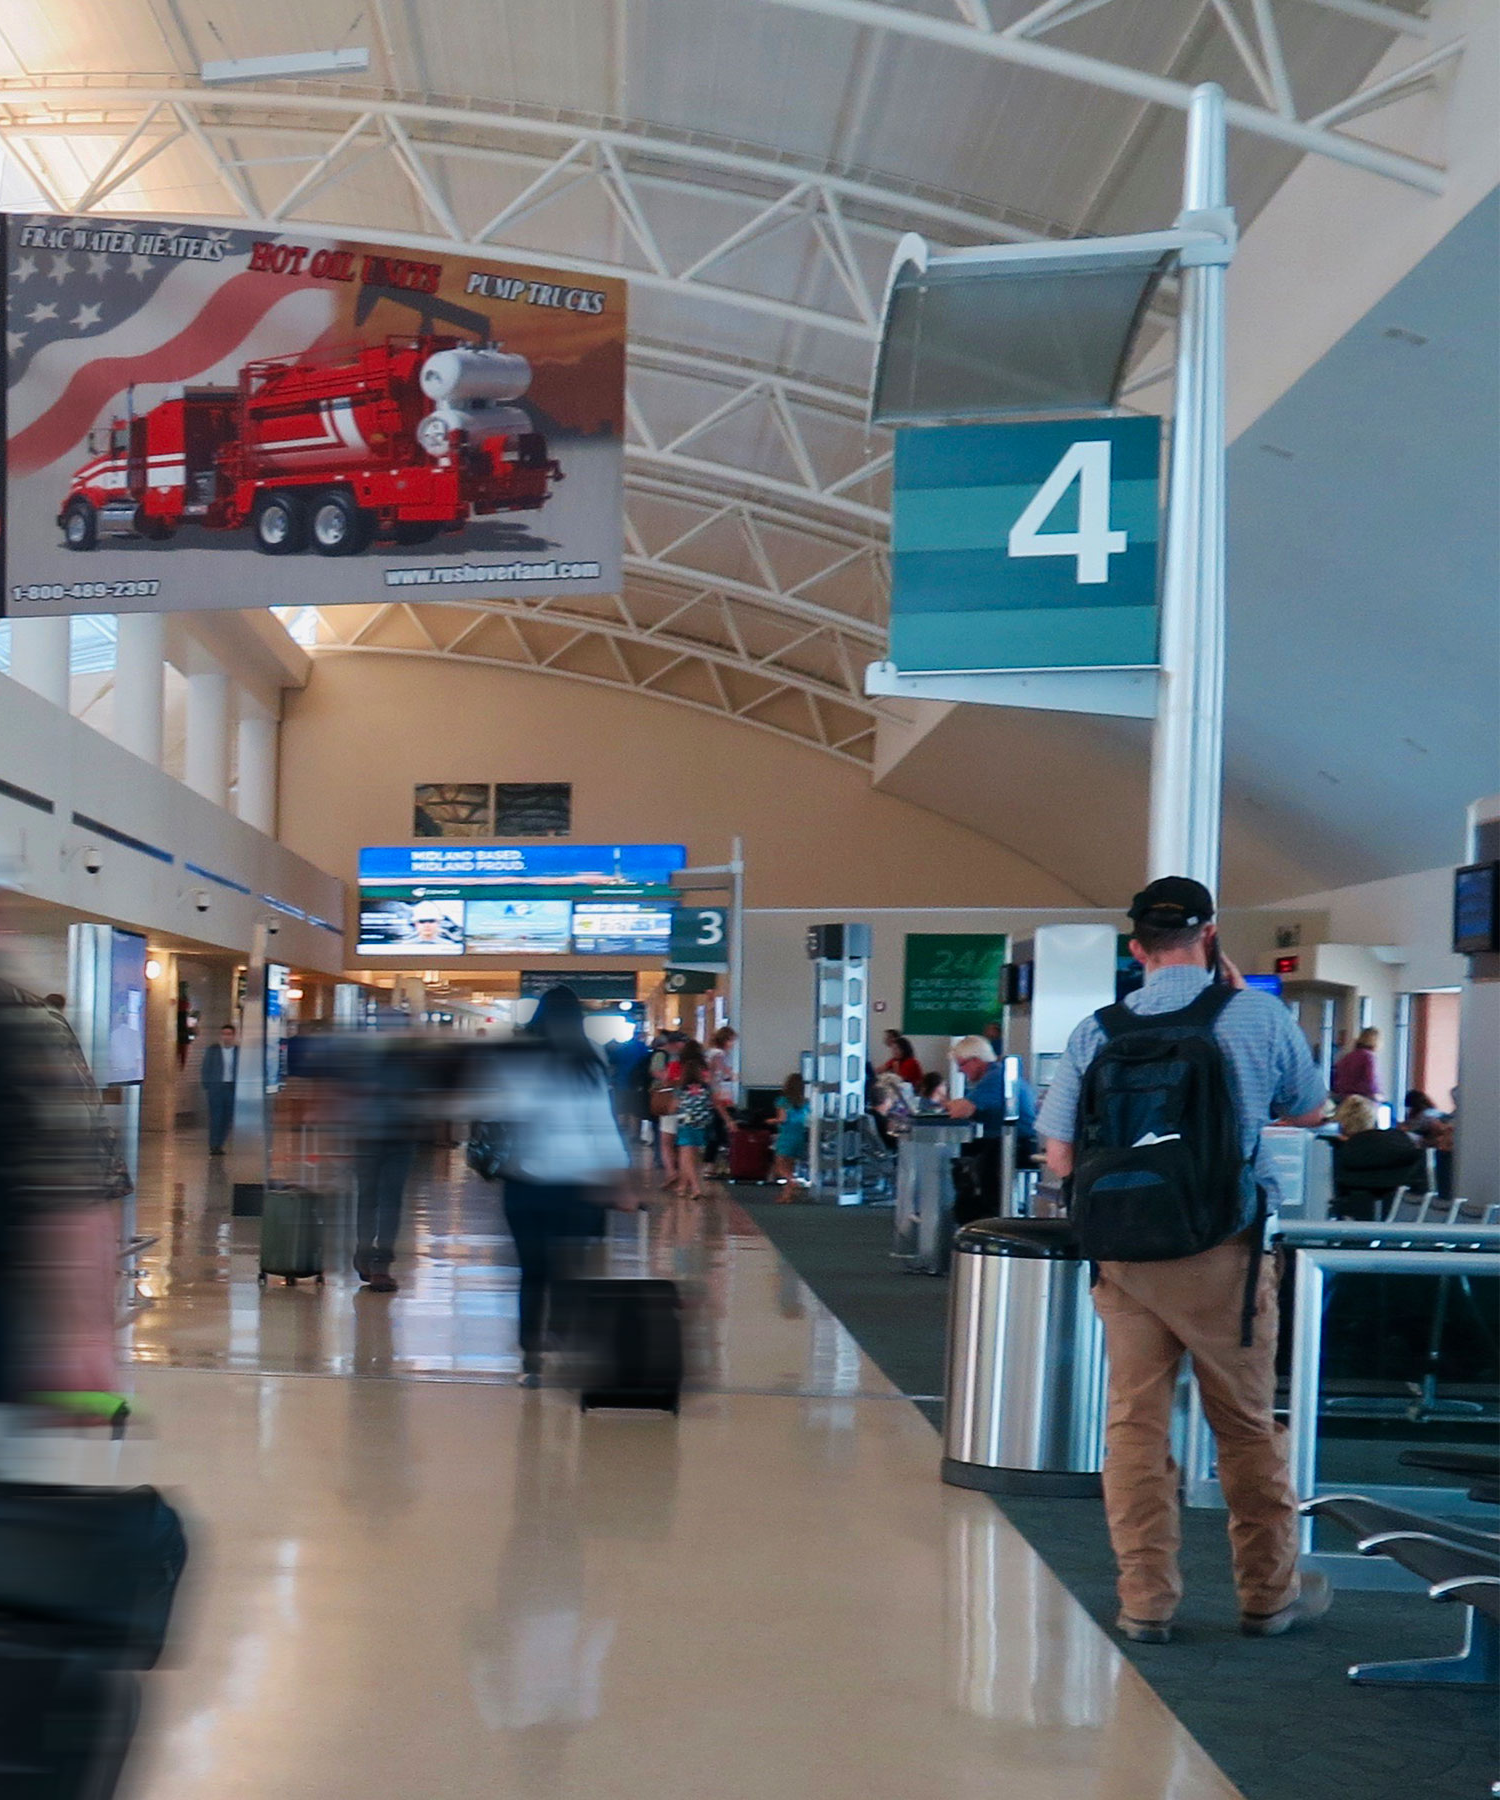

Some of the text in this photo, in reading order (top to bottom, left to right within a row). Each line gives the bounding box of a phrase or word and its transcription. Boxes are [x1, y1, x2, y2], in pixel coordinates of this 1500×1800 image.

[20, 226, 228, 262] FRAC WATER HEATERS
[248, 241, 442, 294] HOT OIL UNITS
[466, 272, 605, 315] PUMP TRUCKS
[1008, 439, 1127, 584] 4
[12, 579, 161, 601] 1-800-489-2397
[386, 559, 599, 586] www.rushoverland.com
[697, 910, 723, 946] 3
